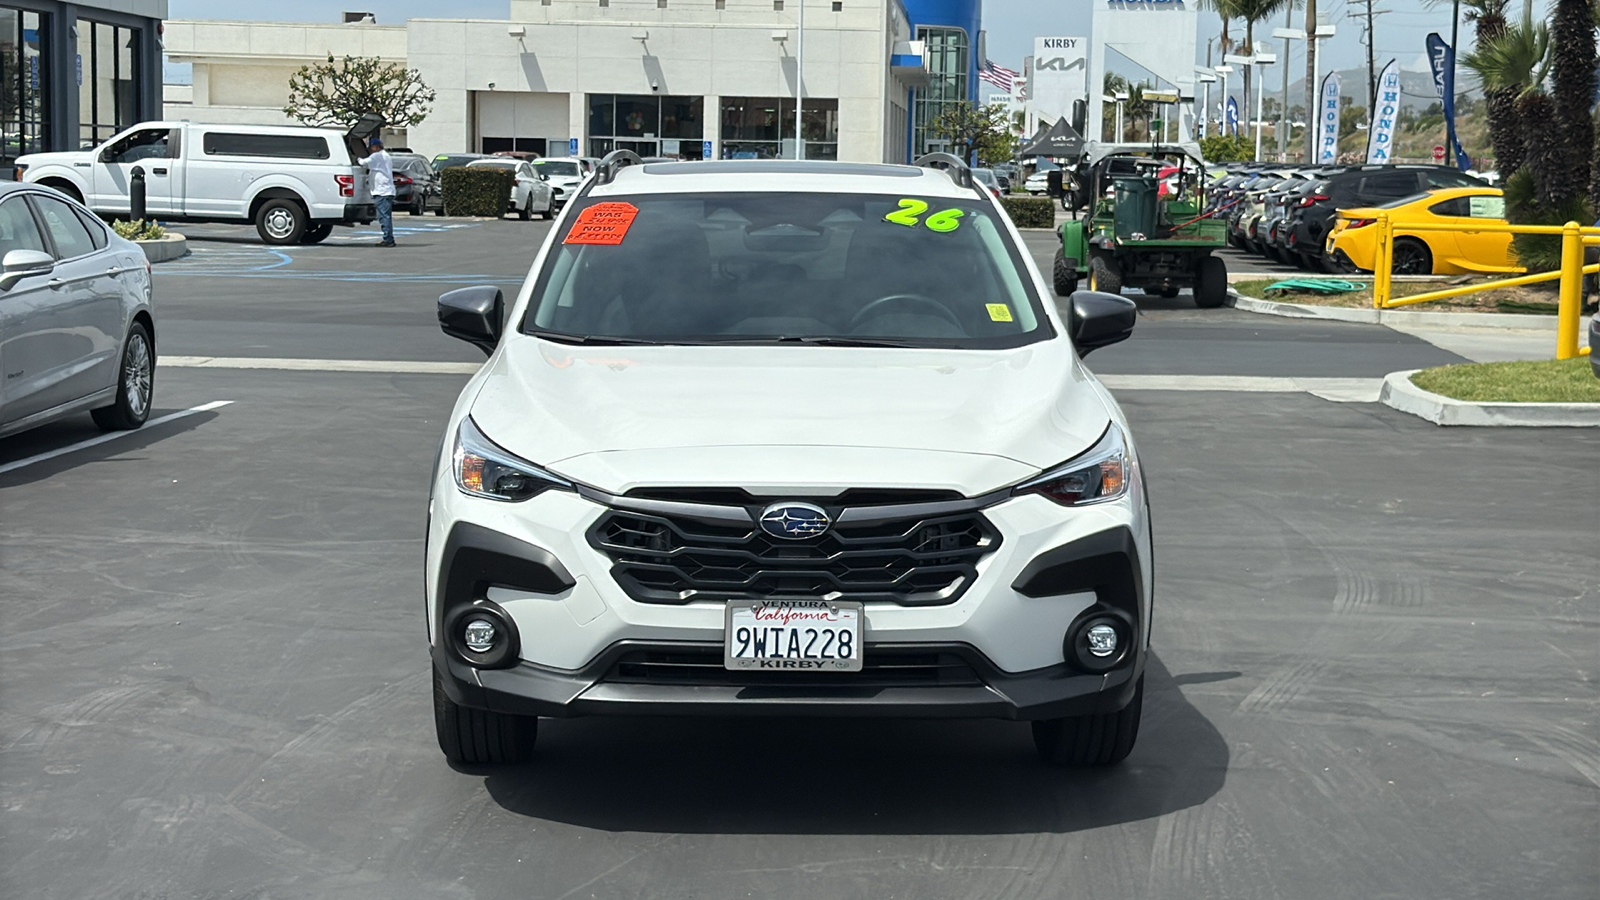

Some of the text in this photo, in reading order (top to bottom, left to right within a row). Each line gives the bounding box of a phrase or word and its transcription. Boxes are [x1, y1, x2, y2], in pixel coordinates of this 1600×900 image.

[1044, 39, 1077, 48] KIRBY
[1036, 57, 1085, 71] KIA
[1434, 46, 1445, 111] BARU
[1322, 100, 1336, 159] HONDA
[1373, 92, 1398, 158] HONDA
[885, 198, 964, 232] 26
[755, 606, 837, 625] California
[735, 627, 852, 659] 9WIA228
[760, 660, 826, 669] KIRBY
